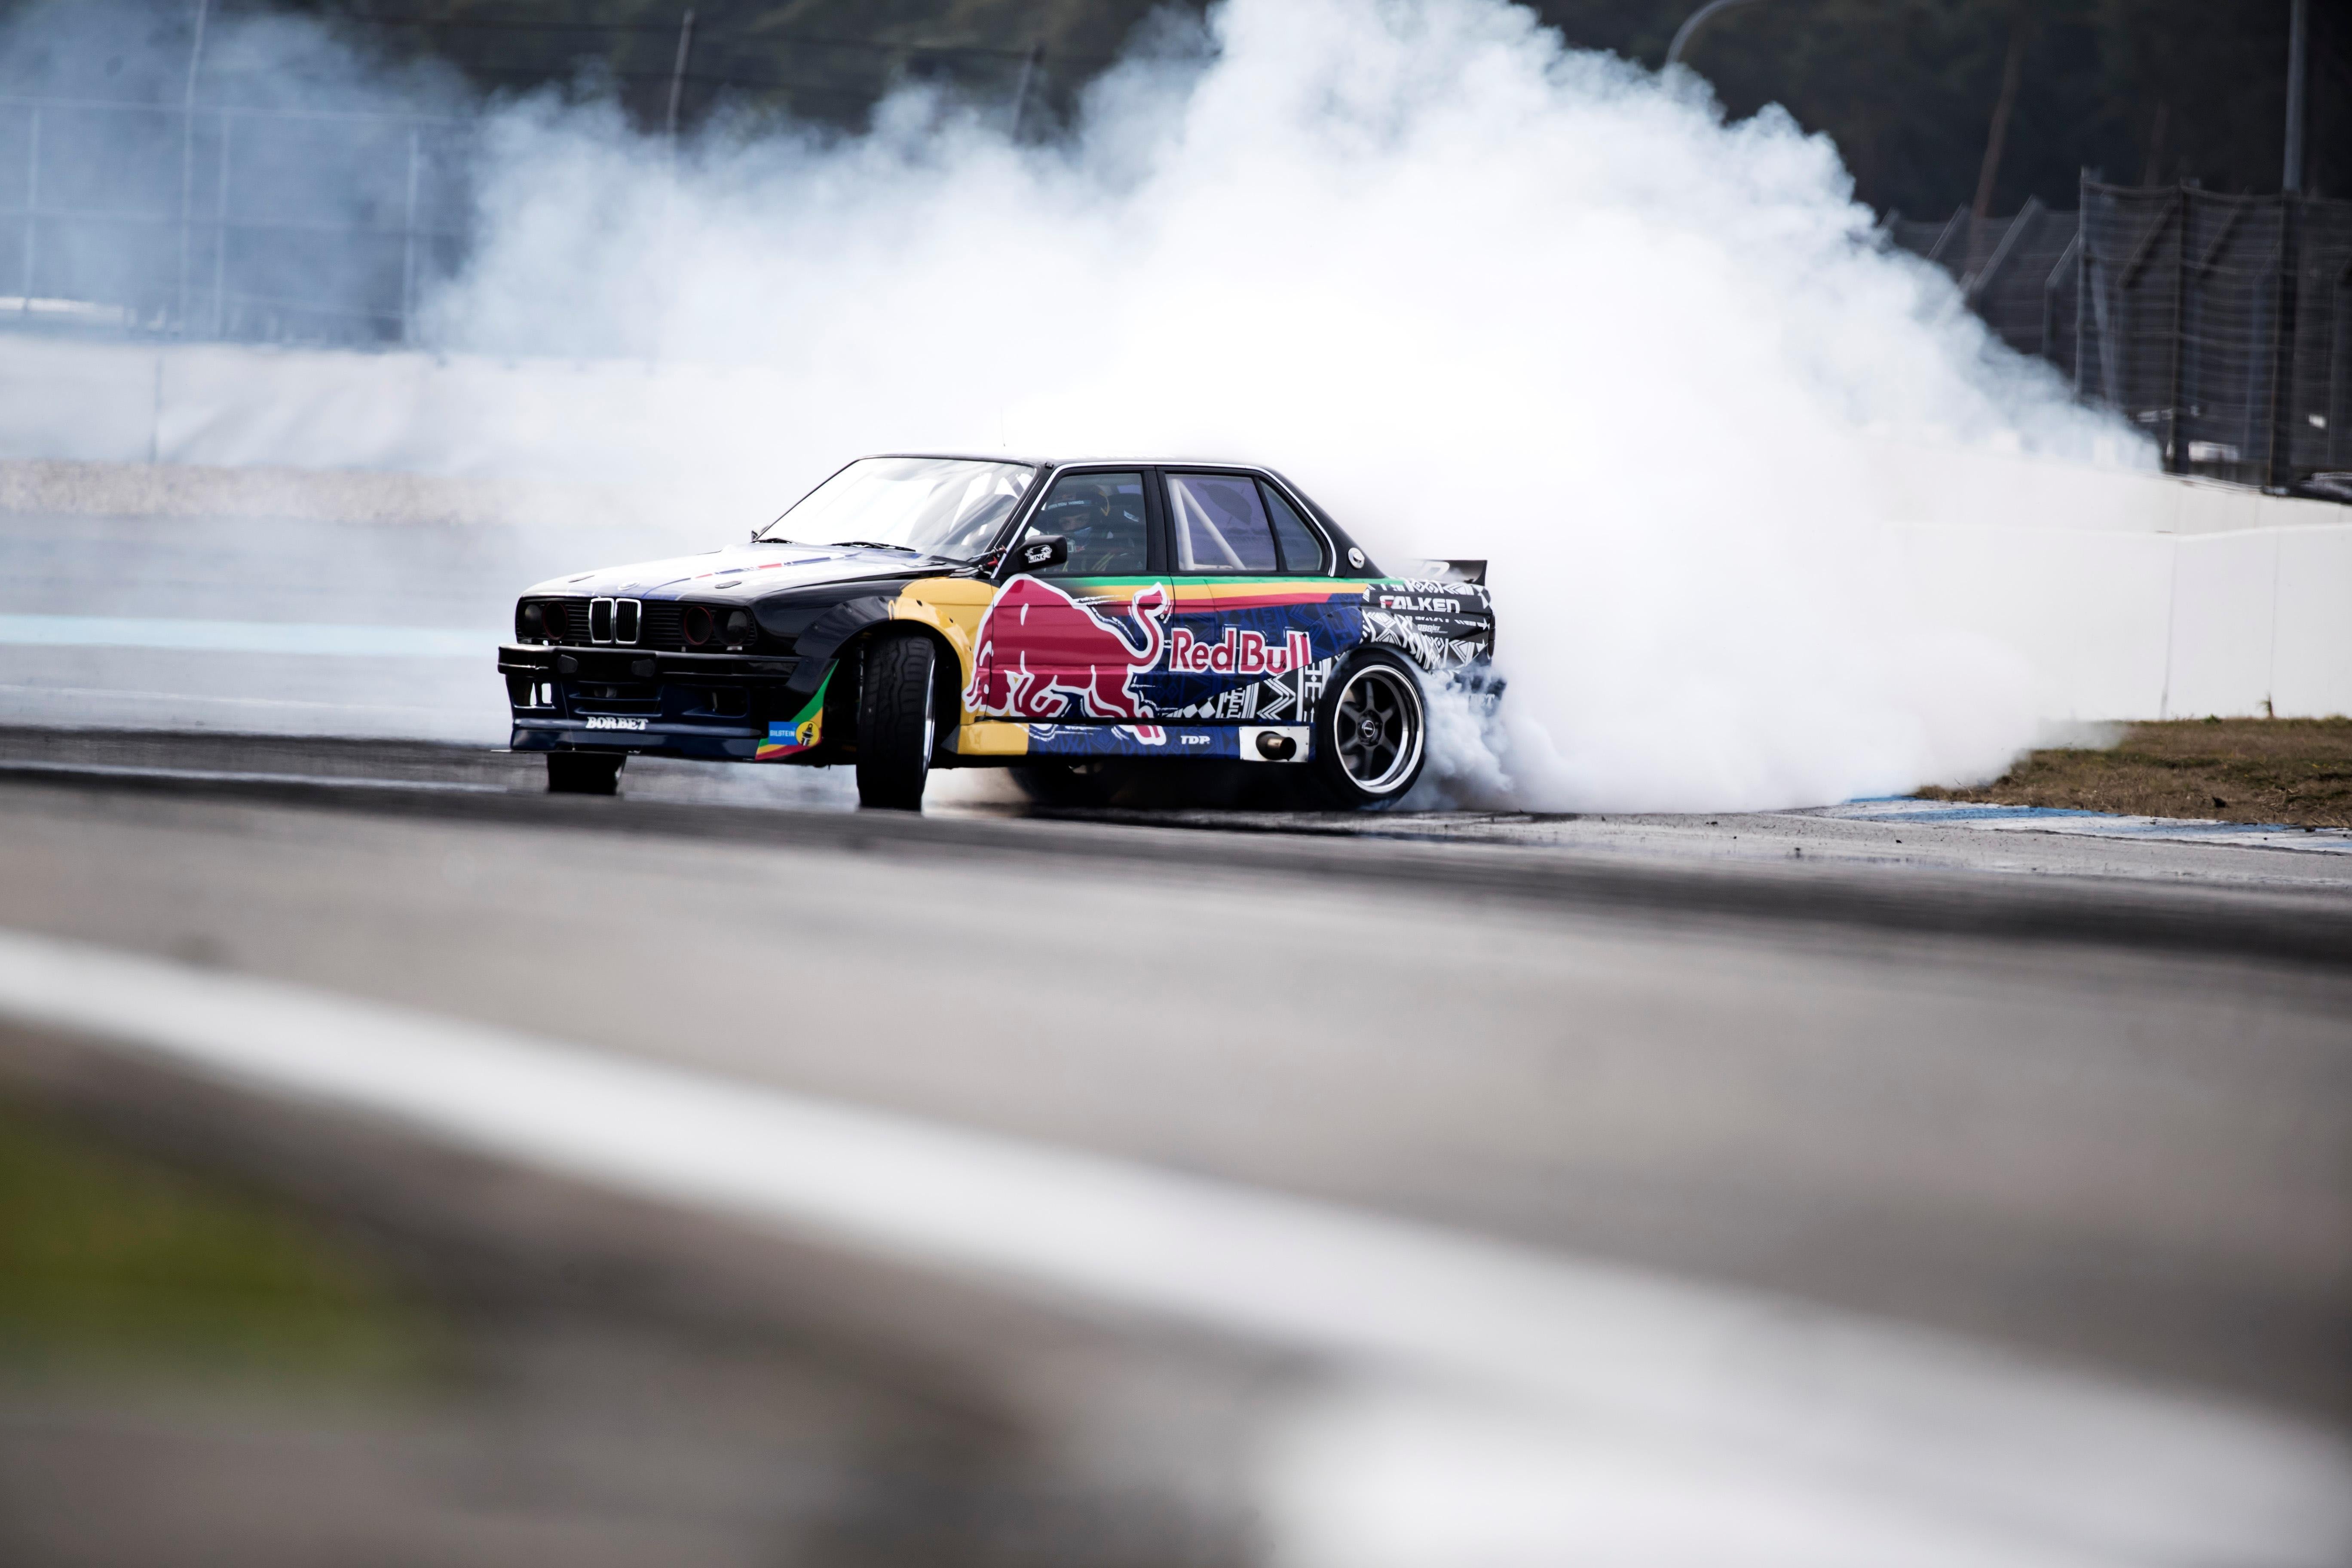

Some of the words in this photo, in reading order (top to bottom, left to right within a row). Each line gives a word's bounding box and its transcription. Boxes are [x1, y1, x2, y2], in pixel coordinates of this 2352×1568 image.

[1379, 595, 1461, 614] FALKEN
[1169, 628, 1237, 674] Red
[1238, 630, 1312, 676] Bull
[585, 716, 649, 730] BORBET
